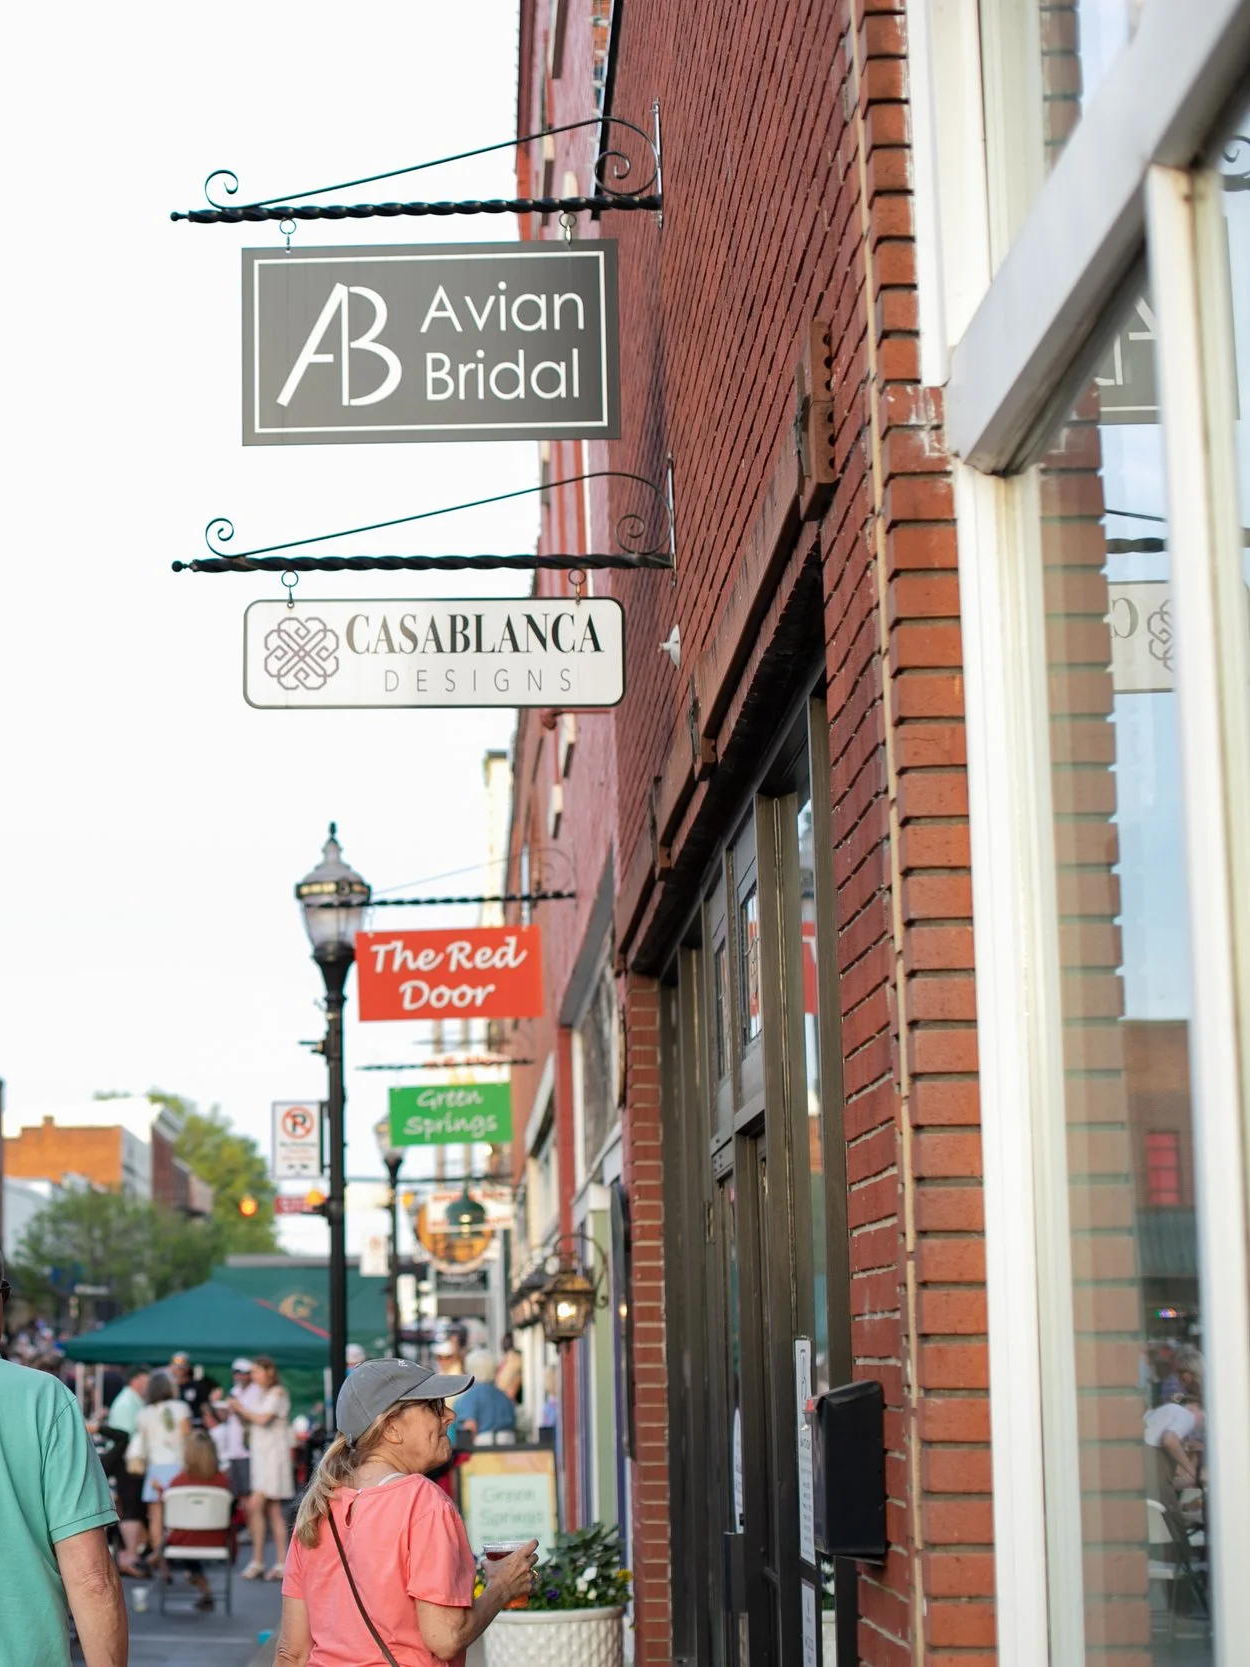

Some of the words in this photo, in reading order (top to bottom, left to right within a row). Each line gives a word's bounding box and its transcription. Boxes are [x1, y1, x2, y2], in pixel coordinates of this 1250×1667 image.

[419, 281, 584, 333] Avian
[276, 282, 403, 407] AB
[425, 348, 580, 401] Bridal
[345, 612, 605, 655] CASABLANCA
[384, 668, 572, 693] DESIGNS
[370, 940, 444, 974] The
[446, 935, 528, 973] Red
[399, 980, 496, 1011] Door
[417, 1089, 484, 1111] Green
[403, 1111, 498, 1142] Springs
